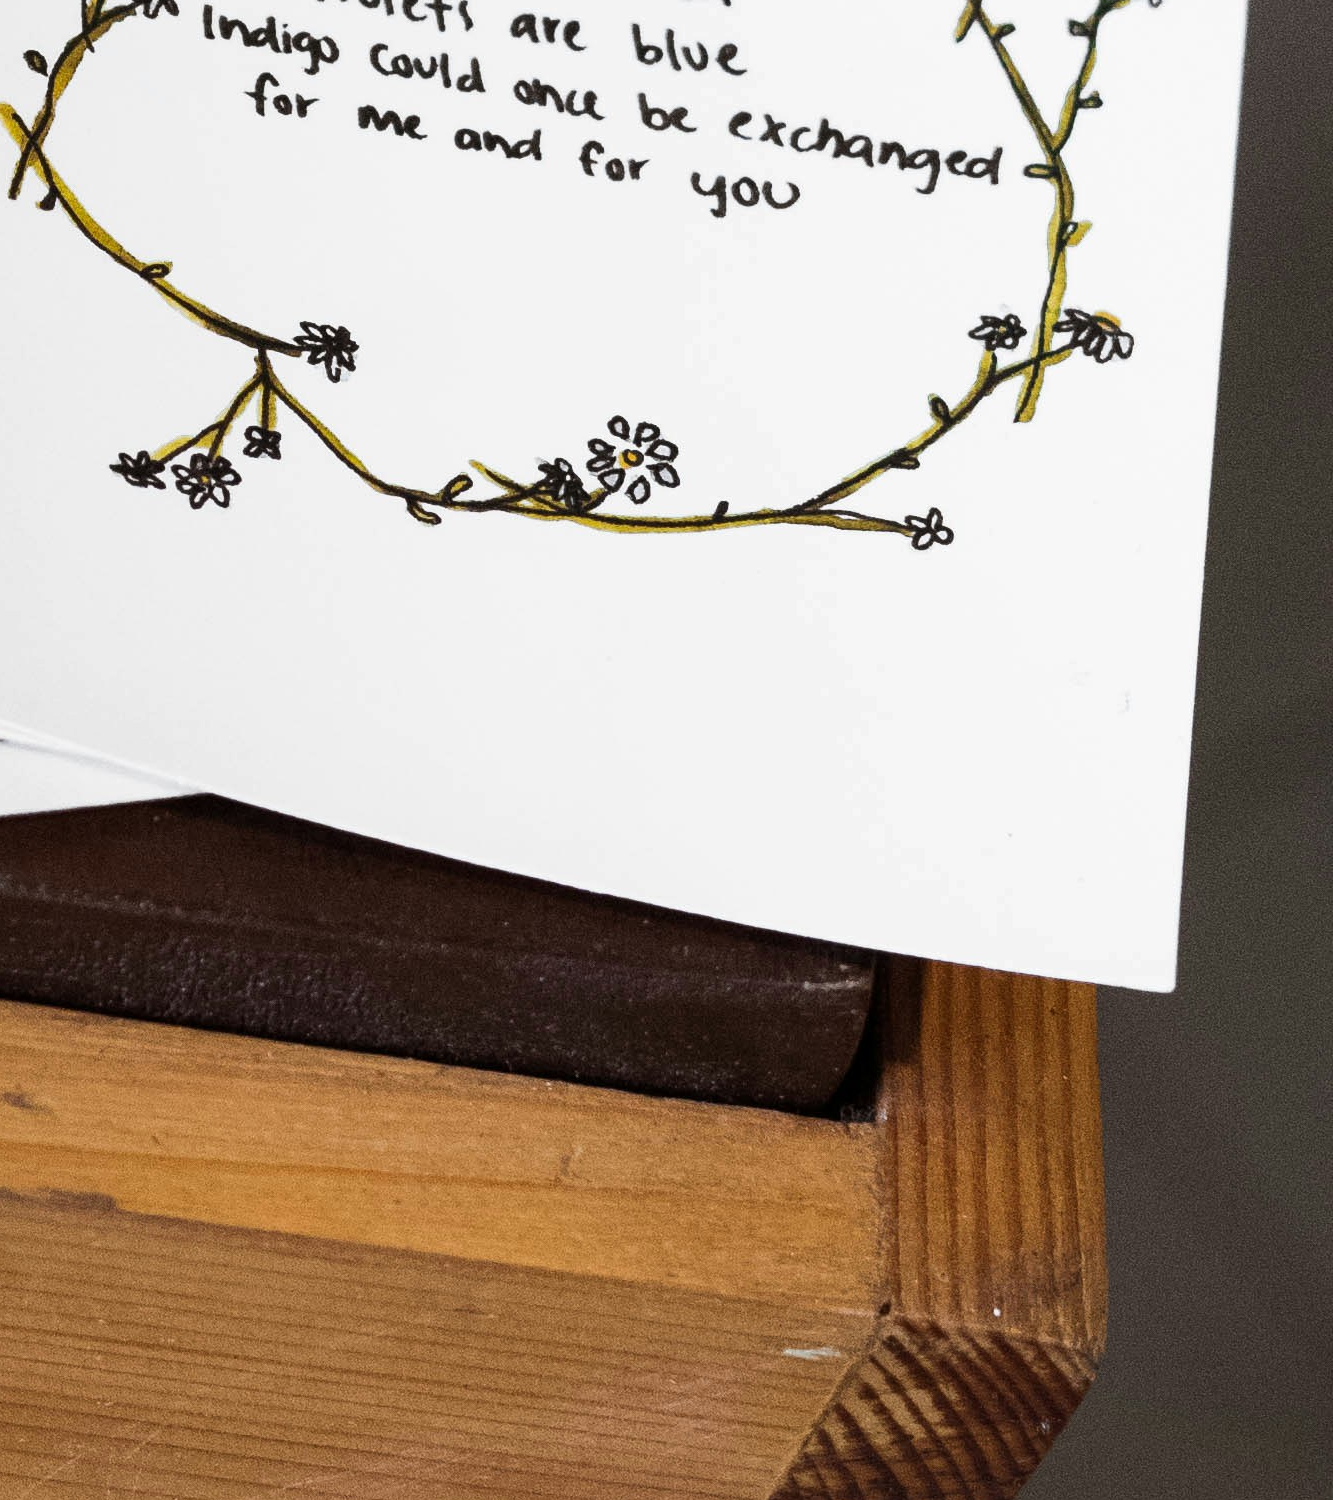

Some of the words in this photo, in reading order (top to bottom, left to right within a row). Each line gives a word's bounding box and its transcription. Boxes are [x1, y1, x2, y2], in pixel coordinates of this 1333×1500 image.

[202, 5, 340, 76] Indigo
[513, 78, 606, 121] once
[638, 93, 698, 133] be
[728, 109, 1005, 195] exchanged
[510, 13, 587, 52] are
[632, 22, 748, 76] blue
[245, 72, 321, 118] for
[357, 104, 429, 140] me
[454, 128, 543, 162] and
[579, 141, 650, 182] for
[690, 171, 801, 219] you
